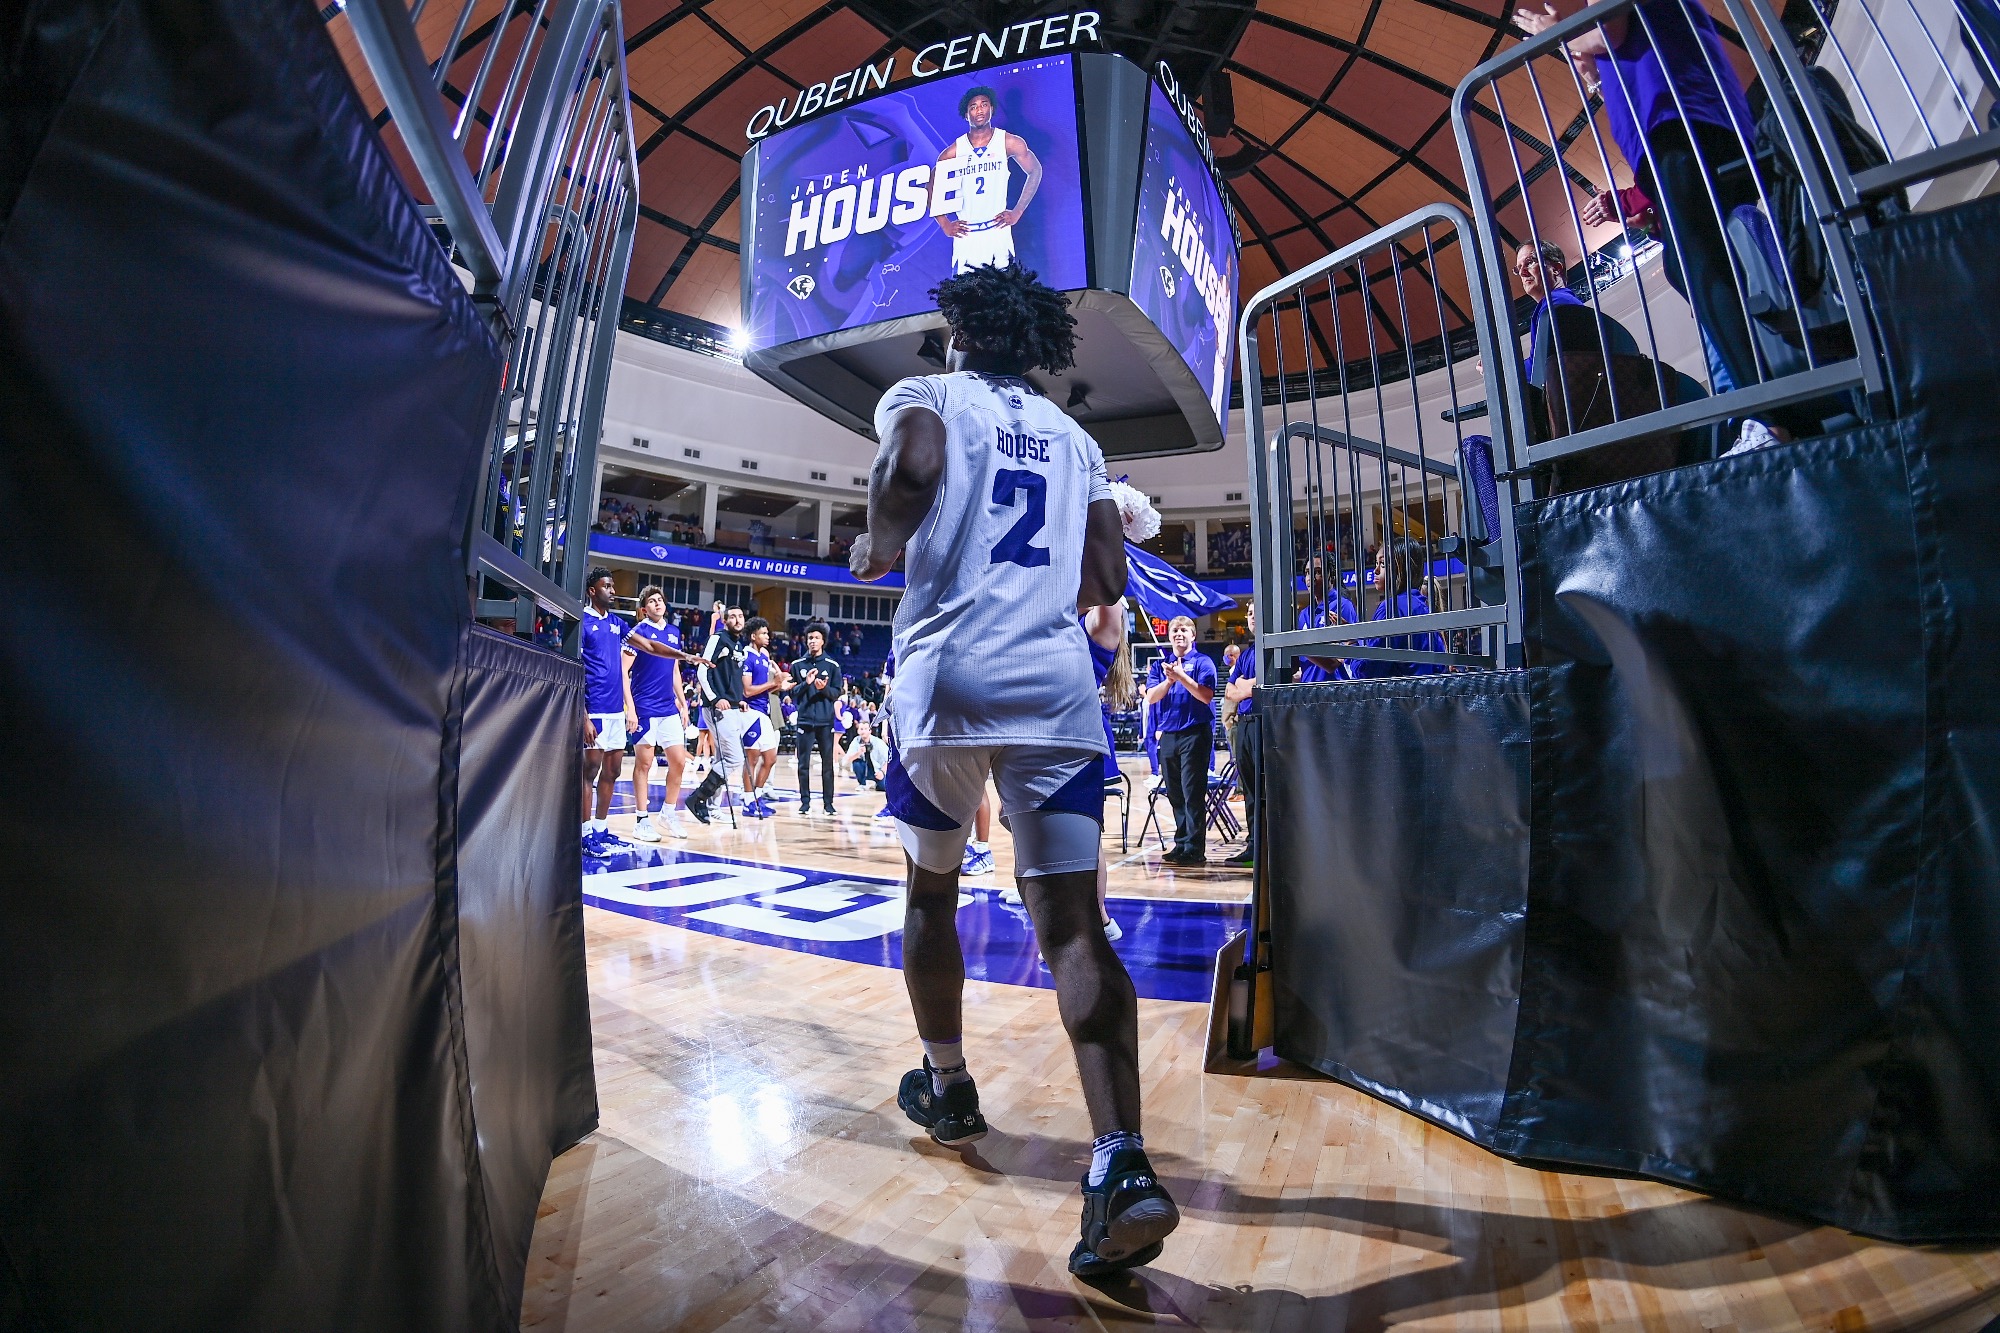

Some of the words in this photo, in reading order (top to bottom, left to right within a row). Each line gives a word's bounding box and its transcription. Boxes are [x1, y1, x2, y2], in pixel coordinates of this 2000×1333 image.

[745, 58, 894, 139] QUBEIN
[911, 11, 1100, 78] CENTER
[1159, 60, 1214, 174] QUBEIN
[791, 163, 868, 200] JADEN
[975, 176, 985, 195] 2
[978, 161, 1002, 173] POINT
[784, 155, 968, 257] HOUSE
[1168, 175, 1204, 237] JADEN
[995, 425, 1051, 463] HOUSE
[989, 467, 1051, 568] 2
[718, 556, 761, 571] JADEN
[765, 561, 808, 576] HOUSE
[1154, 624, 1167, 635] 30
